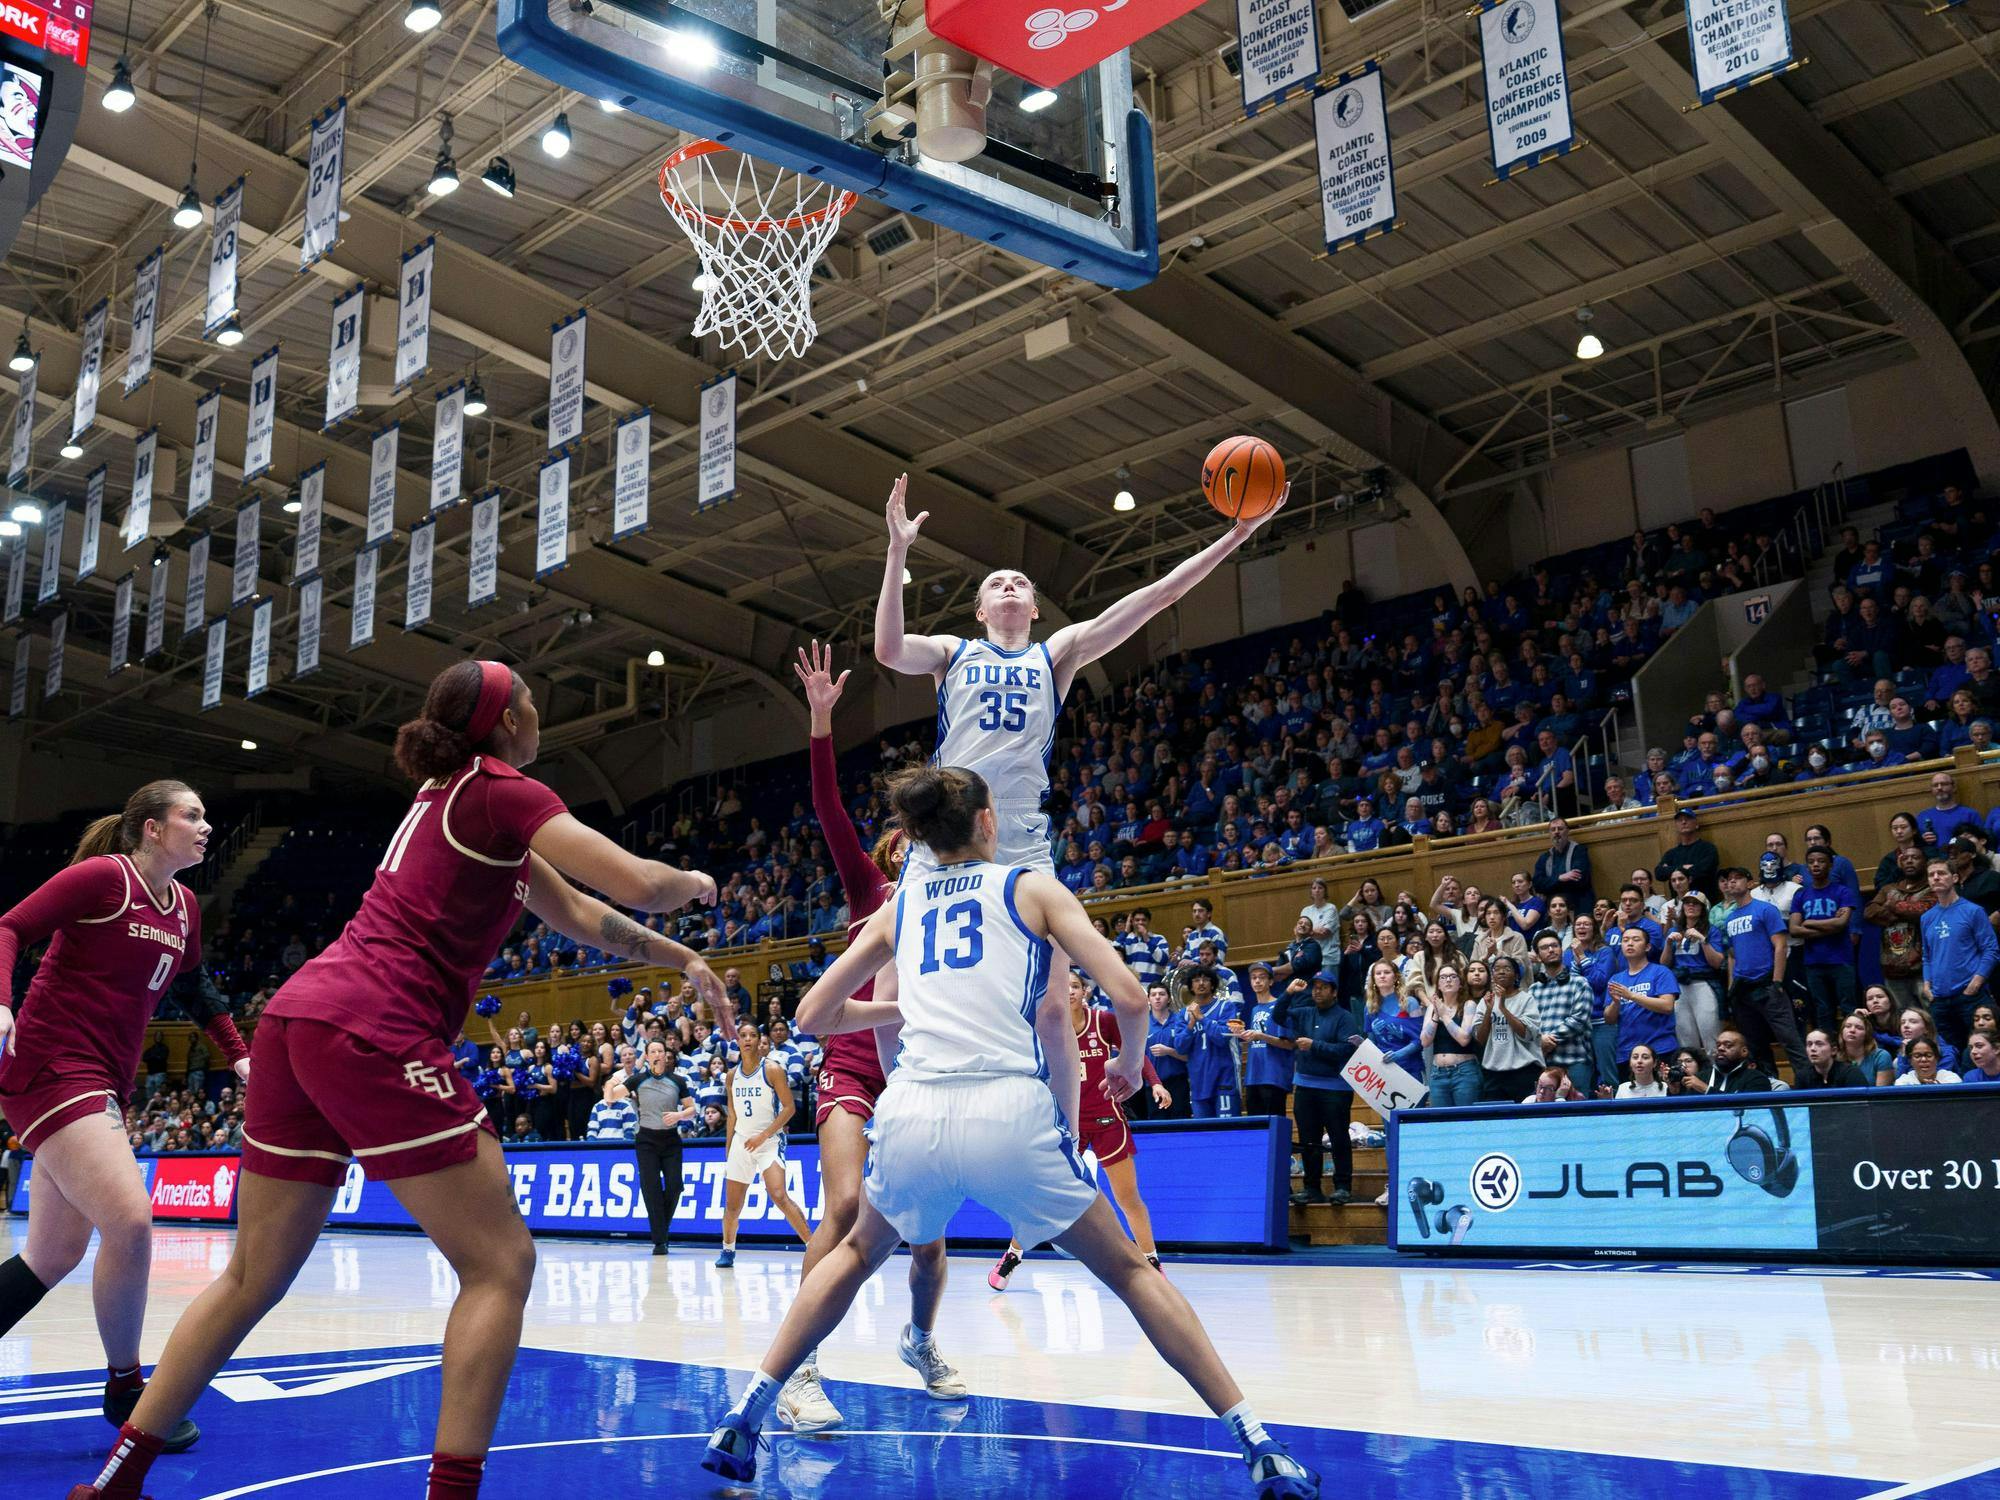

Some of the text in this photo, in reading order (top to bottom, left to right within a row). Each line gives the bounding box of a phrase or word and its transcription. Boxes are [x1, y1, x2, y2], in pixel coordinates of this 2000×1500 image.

[1258, 0, 1290, 25] COAST
[1243, 5, 1310, 48] CONFERENCE
[1701, 5, 1777, 46] CHAMPIONS
[1246, 22, 1309, 61] CHAMPIONS
[1252, 39, 1305, 69] REGULAR SEASON
[1258, 50, 1300, 75] TOURNAMENT
[1499, 47, 1549, 79] ATLANTIC
[1725, 49, 1760, 73] 2010
[1265, 63, 1294, 86] 1964
[1506, 64, 1542, 89] COAST
[1491, 72, 1563, 112] CONFERENCE
[1496, 88, 1561, 125] CHAMPIONS
[1508, 110, 1552, 134] TOURNAMENT
[1329, 133, 1375, 160] ATLANTIC
[1516, 128, 1547, 150] 2009
[1338, 149, 1369, 171] COAST
[312, 154, 337, 199] 24
[1323, 155, 1388, 190] CONFERENCE
[1327, 171, 1386, 203] CHAMPIONS
[1345, 207, 1373, 228] 2006
[214, 230, 235, 266] 43
[556, 365, 578, 383] ATLANTIC
[559, 377, 574, 392] COAST
[551, 384, 582, 408] CONFERENCE
[551, 395, 580, 418] CHAMPIONS
[705, 423, 729, 440] ATLANTIC
[709, 435, 726, 449] COAST
[700, 441, 734, 463] CONFERENCE
[700, 453, 732, 473] CHAMPIONS
[621, 459, 643, 474] ATLANTIC
[623, 470, 639, 482] COAST
[616, 477, 647, 497] CONFERENCE
[617, 489, 645, 506] CHAMPIONS
[544, 502, 563, 516] ATLANTIC
[540, 519, 566, 537] CONFERENCE
[540, 529, 565, 546] CHAMPIONS
[1749, 603, 1768, 621] 14
[965, 664, 1041, 690] DUKE
[979, 691, 1028, 732] 35
[1420, 793, 1445, 805] DUKE
[379, 801, 432, 873] 11
[925, 874, 983, 900] WOOD
[920, 898, 983, 976] 13
[147, 953, 174, 991] 0
[402, 1060, 457, 1100] FSU
[735, 1086, 763, 1098] DUKE
[743, 1100, 754, 1118] 3
[1528, 1160, 1725, 1199] JLAB
[1853, 1160, 1934, 1190] Over
[1943, 1159, 1983, 1190] 30
[152, 1177, 212, 1208] Ameritas
